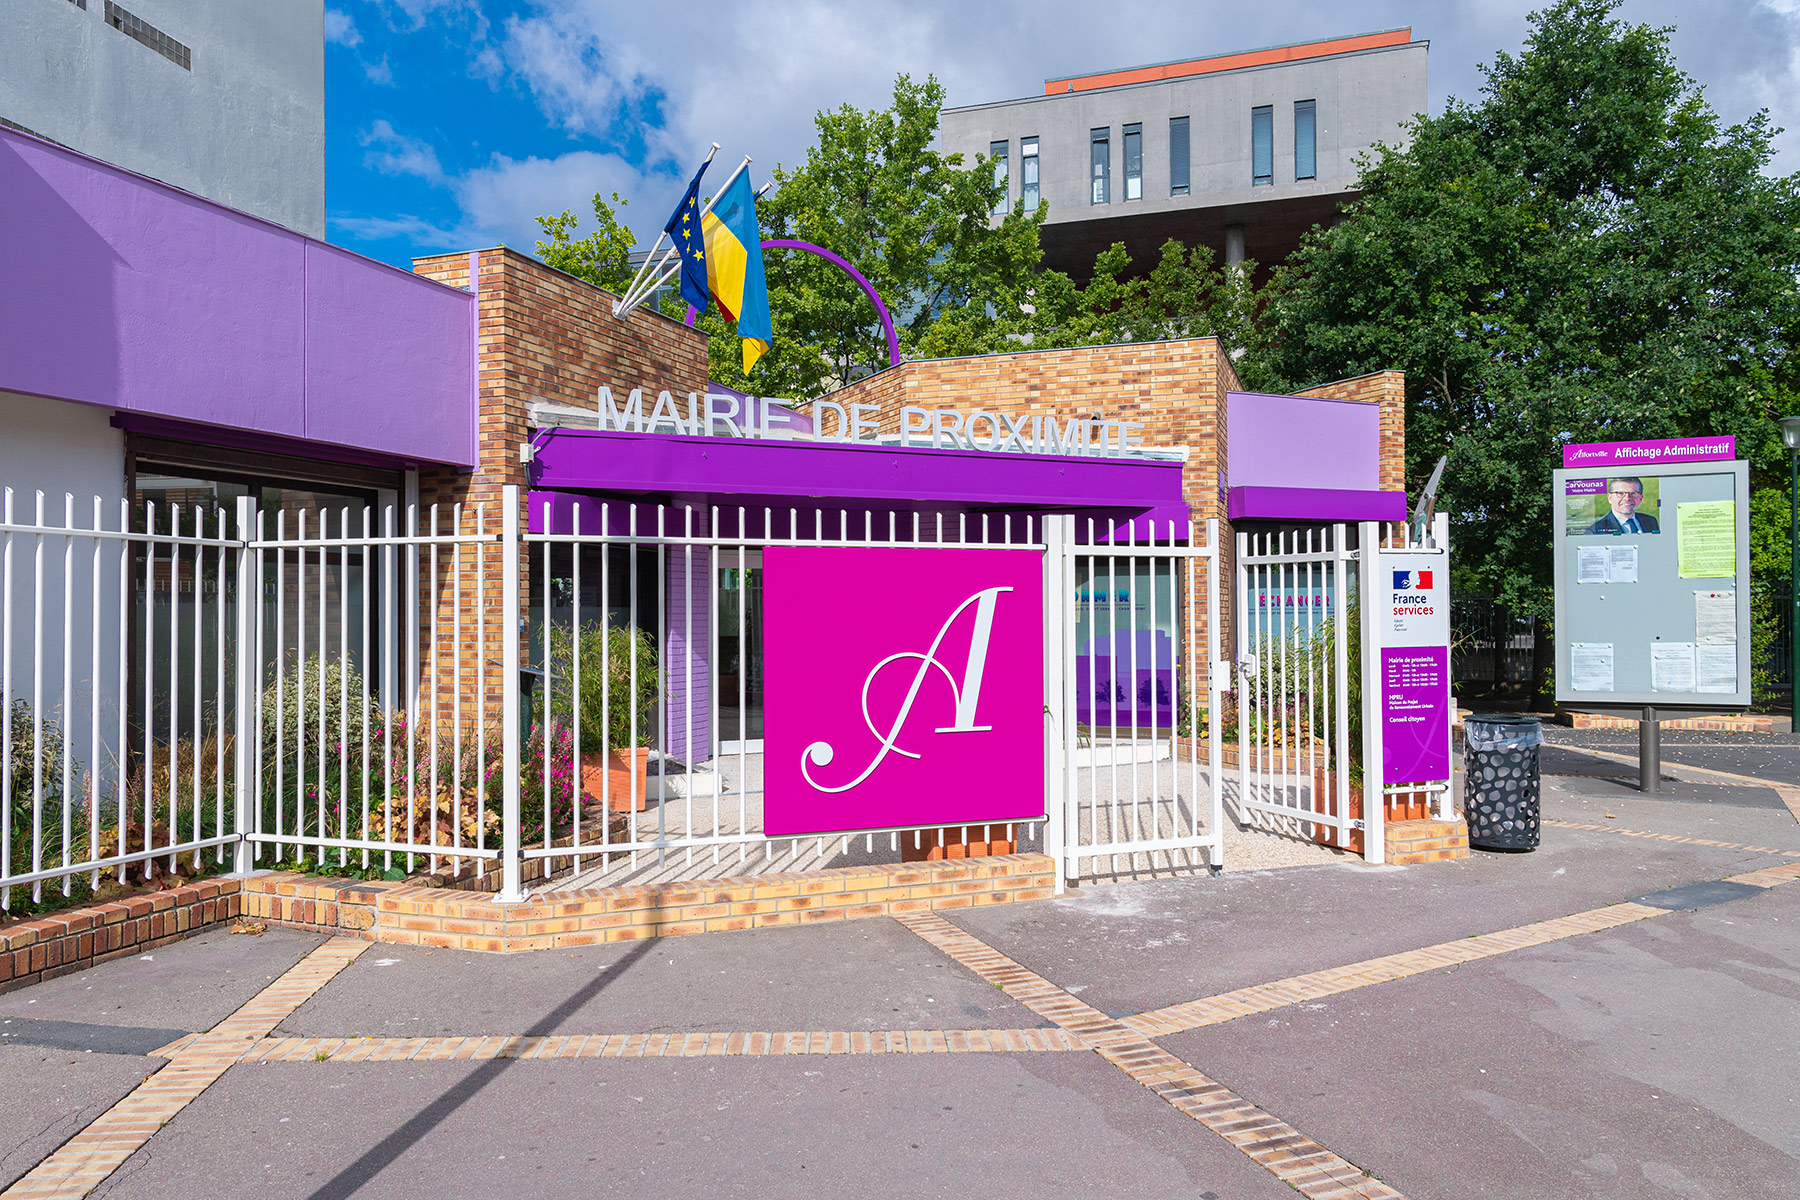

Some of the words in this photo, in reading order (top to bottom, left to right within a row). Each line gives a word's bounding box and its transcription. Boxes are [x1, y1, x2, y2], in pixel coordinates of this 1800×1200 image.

[597, 386, 794, 442] MAIRIE
[812, 400, 883, 446] DE
[1614, 447, 1661, 459] Affichage
[1663, 443, 1730, 456] Administratif
[1565, 481, 1604, 489] Carvounas
[1393, 593, 1427, 604] France
[1393, 604, 1434, 615] services
[800, 586, 1014, 793] A
